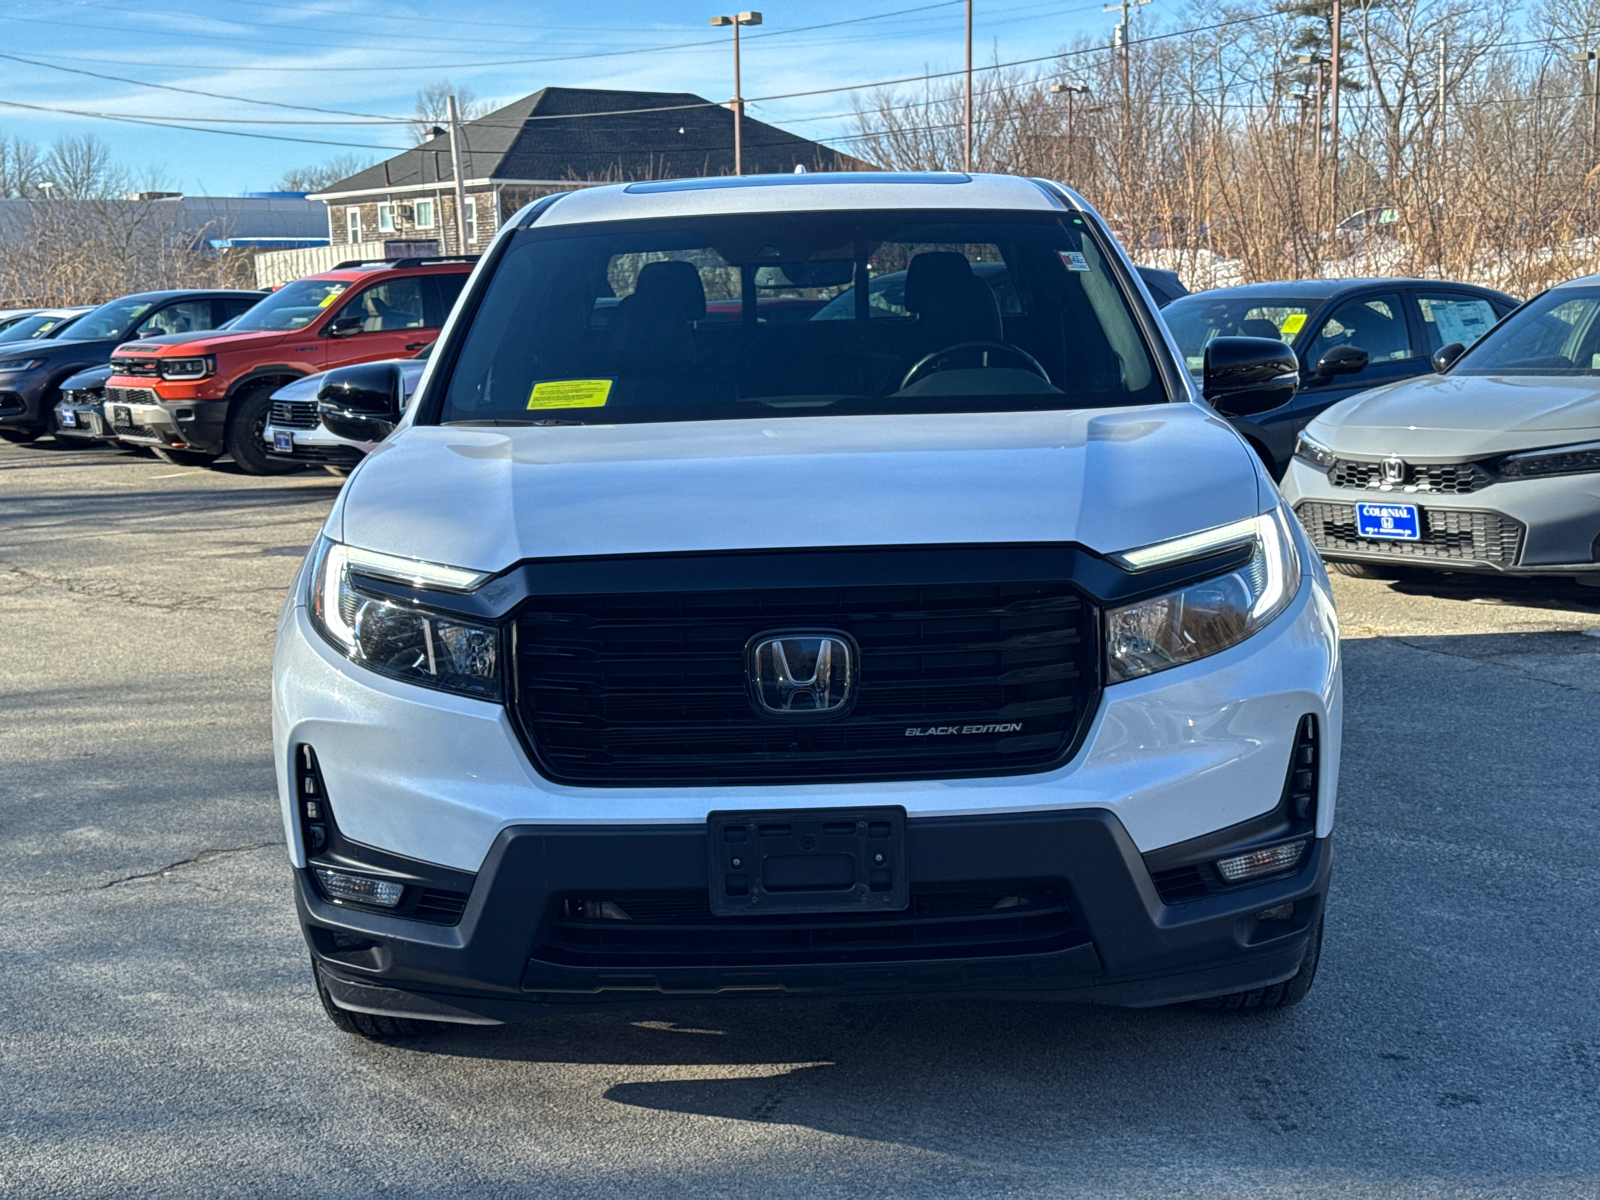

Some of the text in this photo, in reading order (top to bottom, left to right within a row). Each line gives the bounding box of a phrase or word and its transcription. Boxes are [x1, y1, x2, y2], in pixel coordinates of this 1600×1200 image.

[1362, 507, 1411, 518] COLONIAL
[904, 723, 1022, 737] BLACK EDITION
